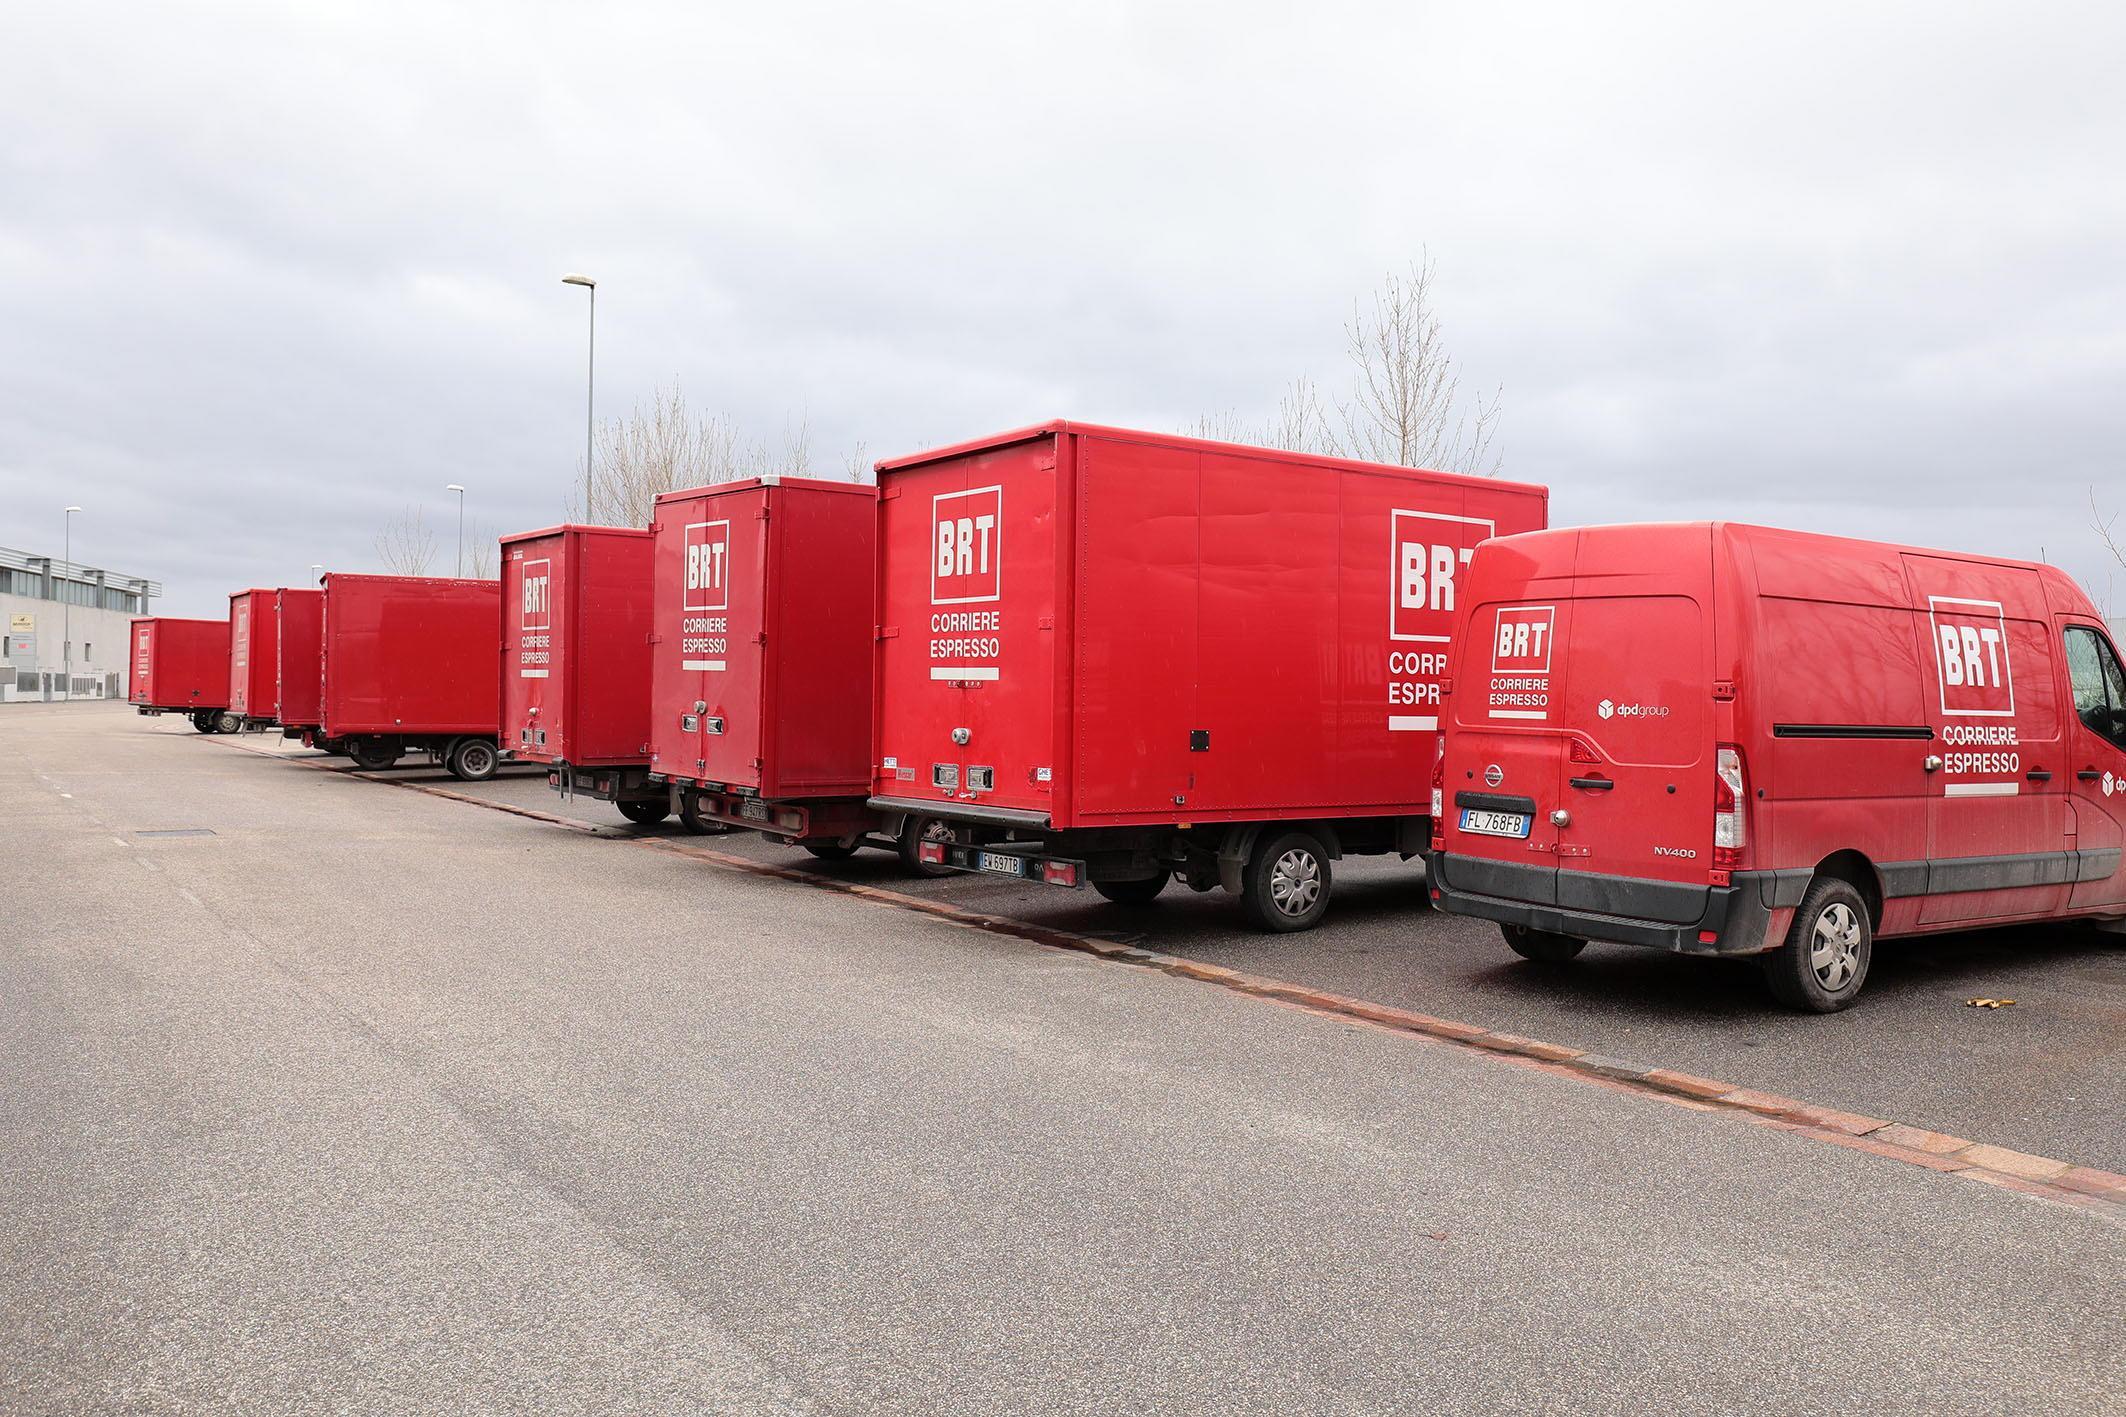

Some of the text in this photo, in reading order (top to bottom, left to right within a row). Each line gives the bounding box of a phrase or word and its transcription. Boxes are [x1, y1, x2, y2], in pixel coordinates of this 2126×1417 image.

[938, 514, 994, 577] BRT
[688, 542, 725, 590] BRT
[525, 576, 547, 613] BRT
[683, 617, 727, 633] CORRIERE
[931, 611, 1000, 633] CORRIERE
[521, 635, 550, 648] CORRIERE
[683, 637, 726, 654] ESPRESSO
[930, 637, 999, 658] ESPRESSO
[1498, 623, 1547, 657] BRT
[521, 651, 549, 664] ESPRESSO
[1389, 651, 1447, 675] CORR
[1939, 624, 2000, 688] BRT
[1388, 682, 1440, 705] ESPR
[1490, 678, 1549, 691] CORRIERE
[1489, 693, 1548, 707] ESPRESSO
[1617, 703, 1669, 718] dpdgroup
[1942, 725, 2019, 746] CORRIERE
[1944, 752, 2020, 774] ESPRESSO
[1467, 811, 1522, 833] FL 768FB
[1654, 846, 1696, 859] NV400
